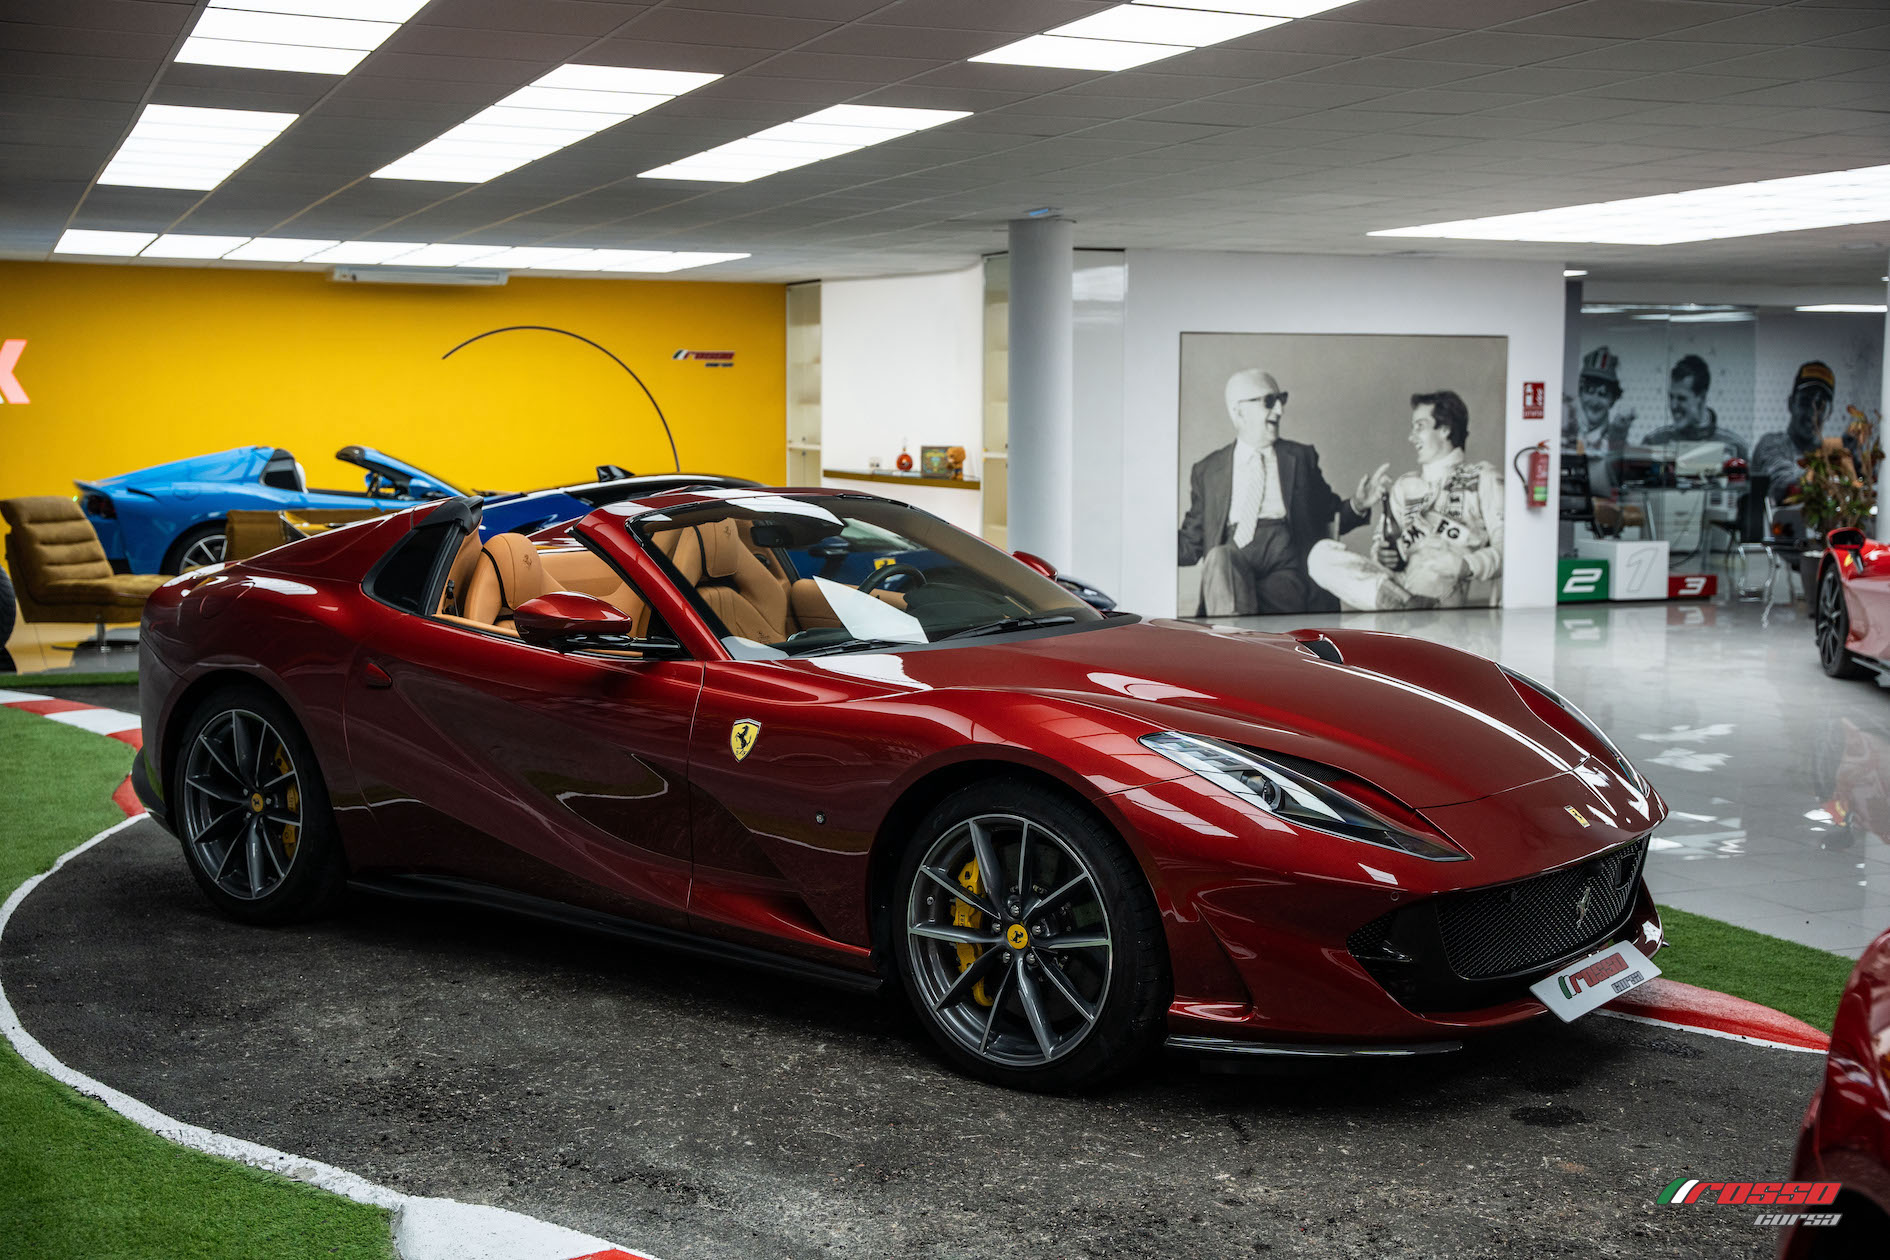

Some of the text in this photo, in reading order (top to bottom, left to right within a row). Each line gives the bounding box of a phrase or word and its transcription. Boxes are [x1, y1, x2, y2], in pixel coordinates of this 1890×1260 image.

[1562, 568, 1603, 594] 2
[1626, 547, 1659, 593] 1
[1678, 577, 1707, 596] 3
